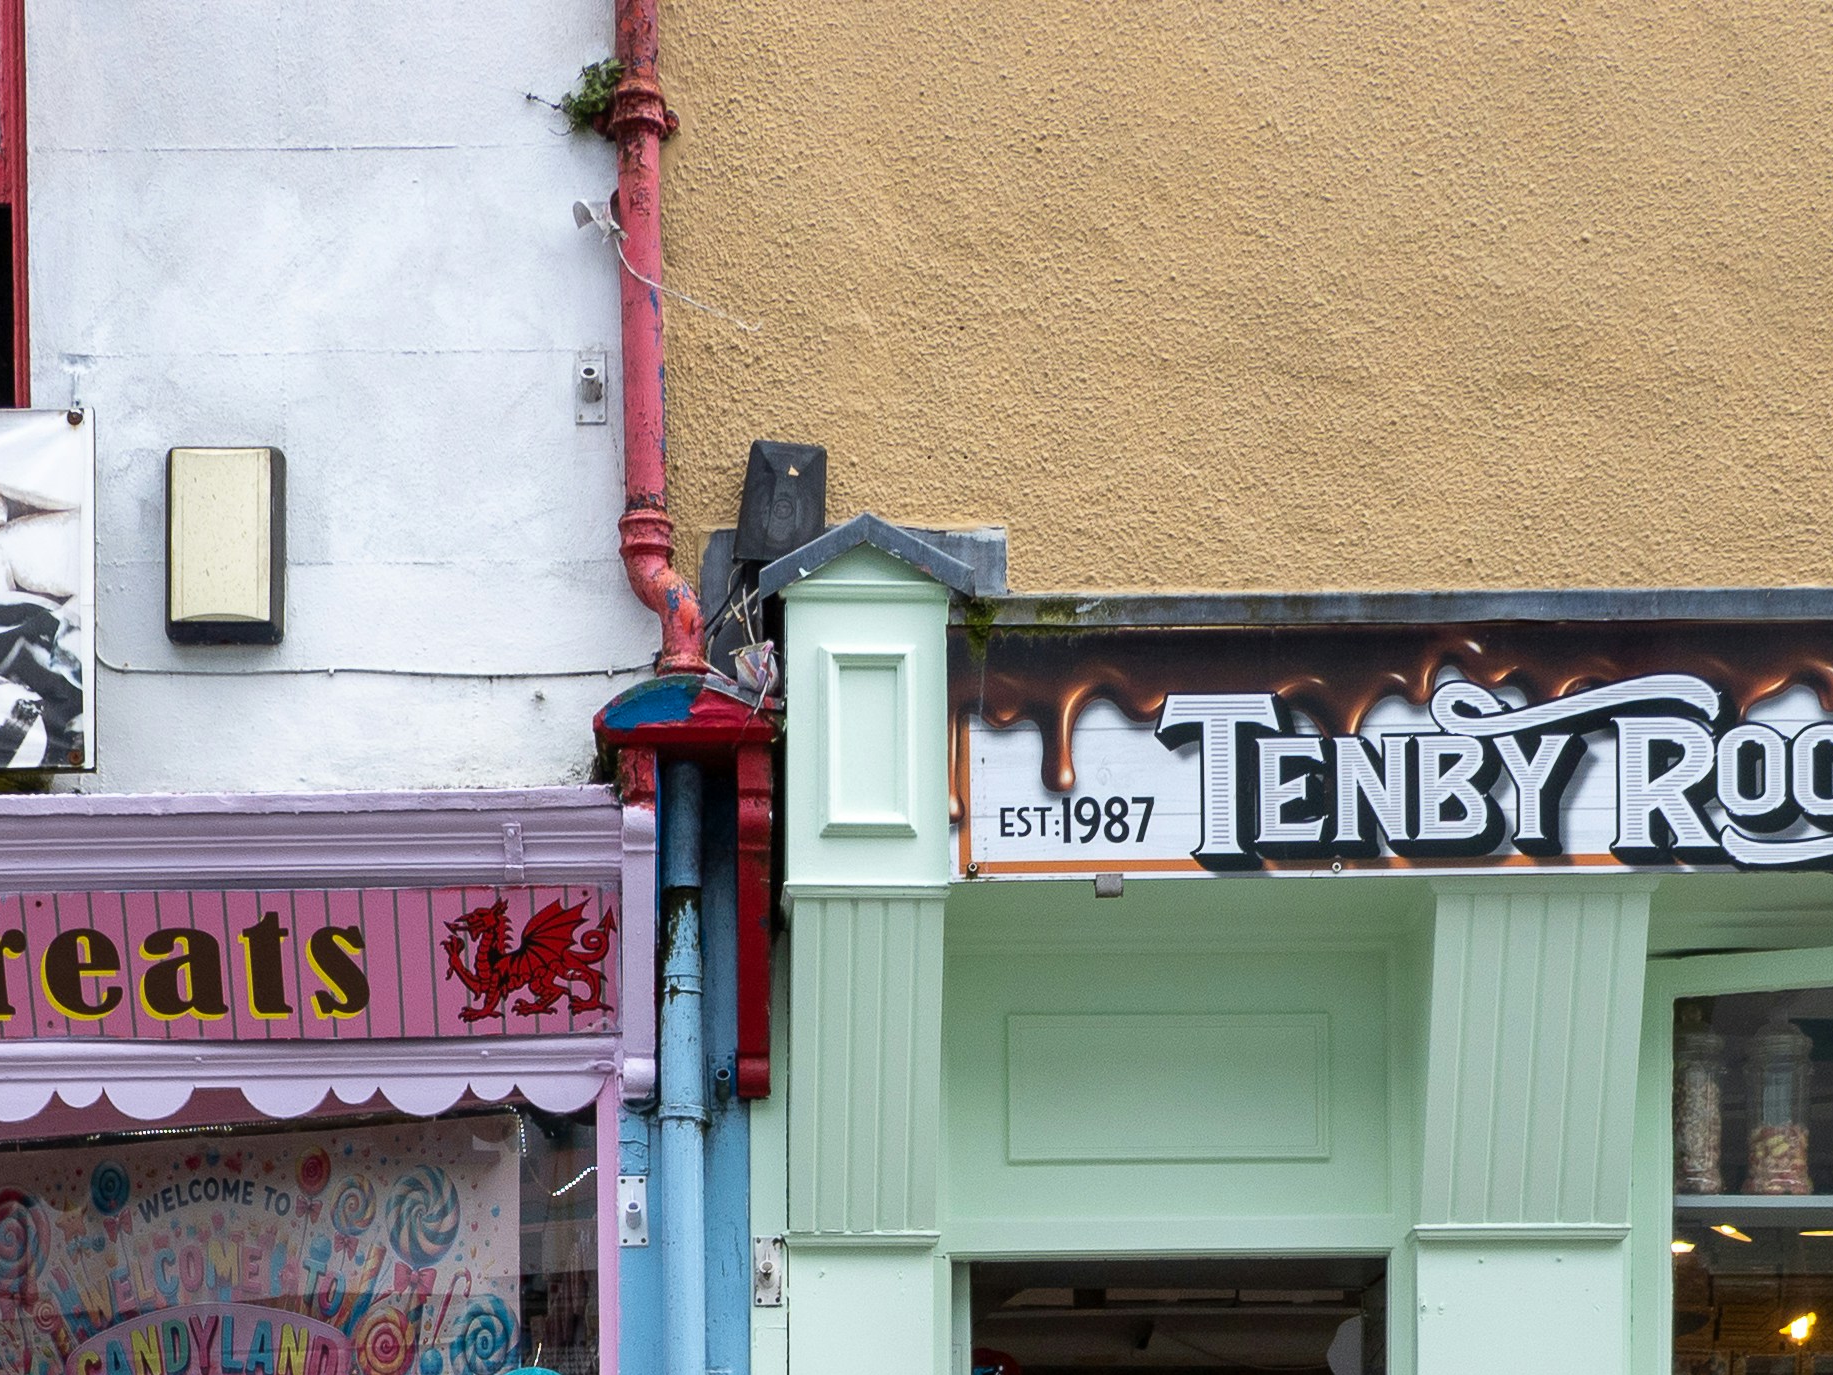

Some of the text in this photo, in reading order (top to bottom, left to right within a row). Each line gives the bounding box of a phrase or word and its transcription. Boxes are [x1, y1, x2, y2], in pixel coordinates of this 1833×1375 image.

[1155, 690, 1579, 866] TENBY
[138, 1178, 292, 1225] WELCOME TO
[72, 1237, 348, 1328] WELCOME TO
